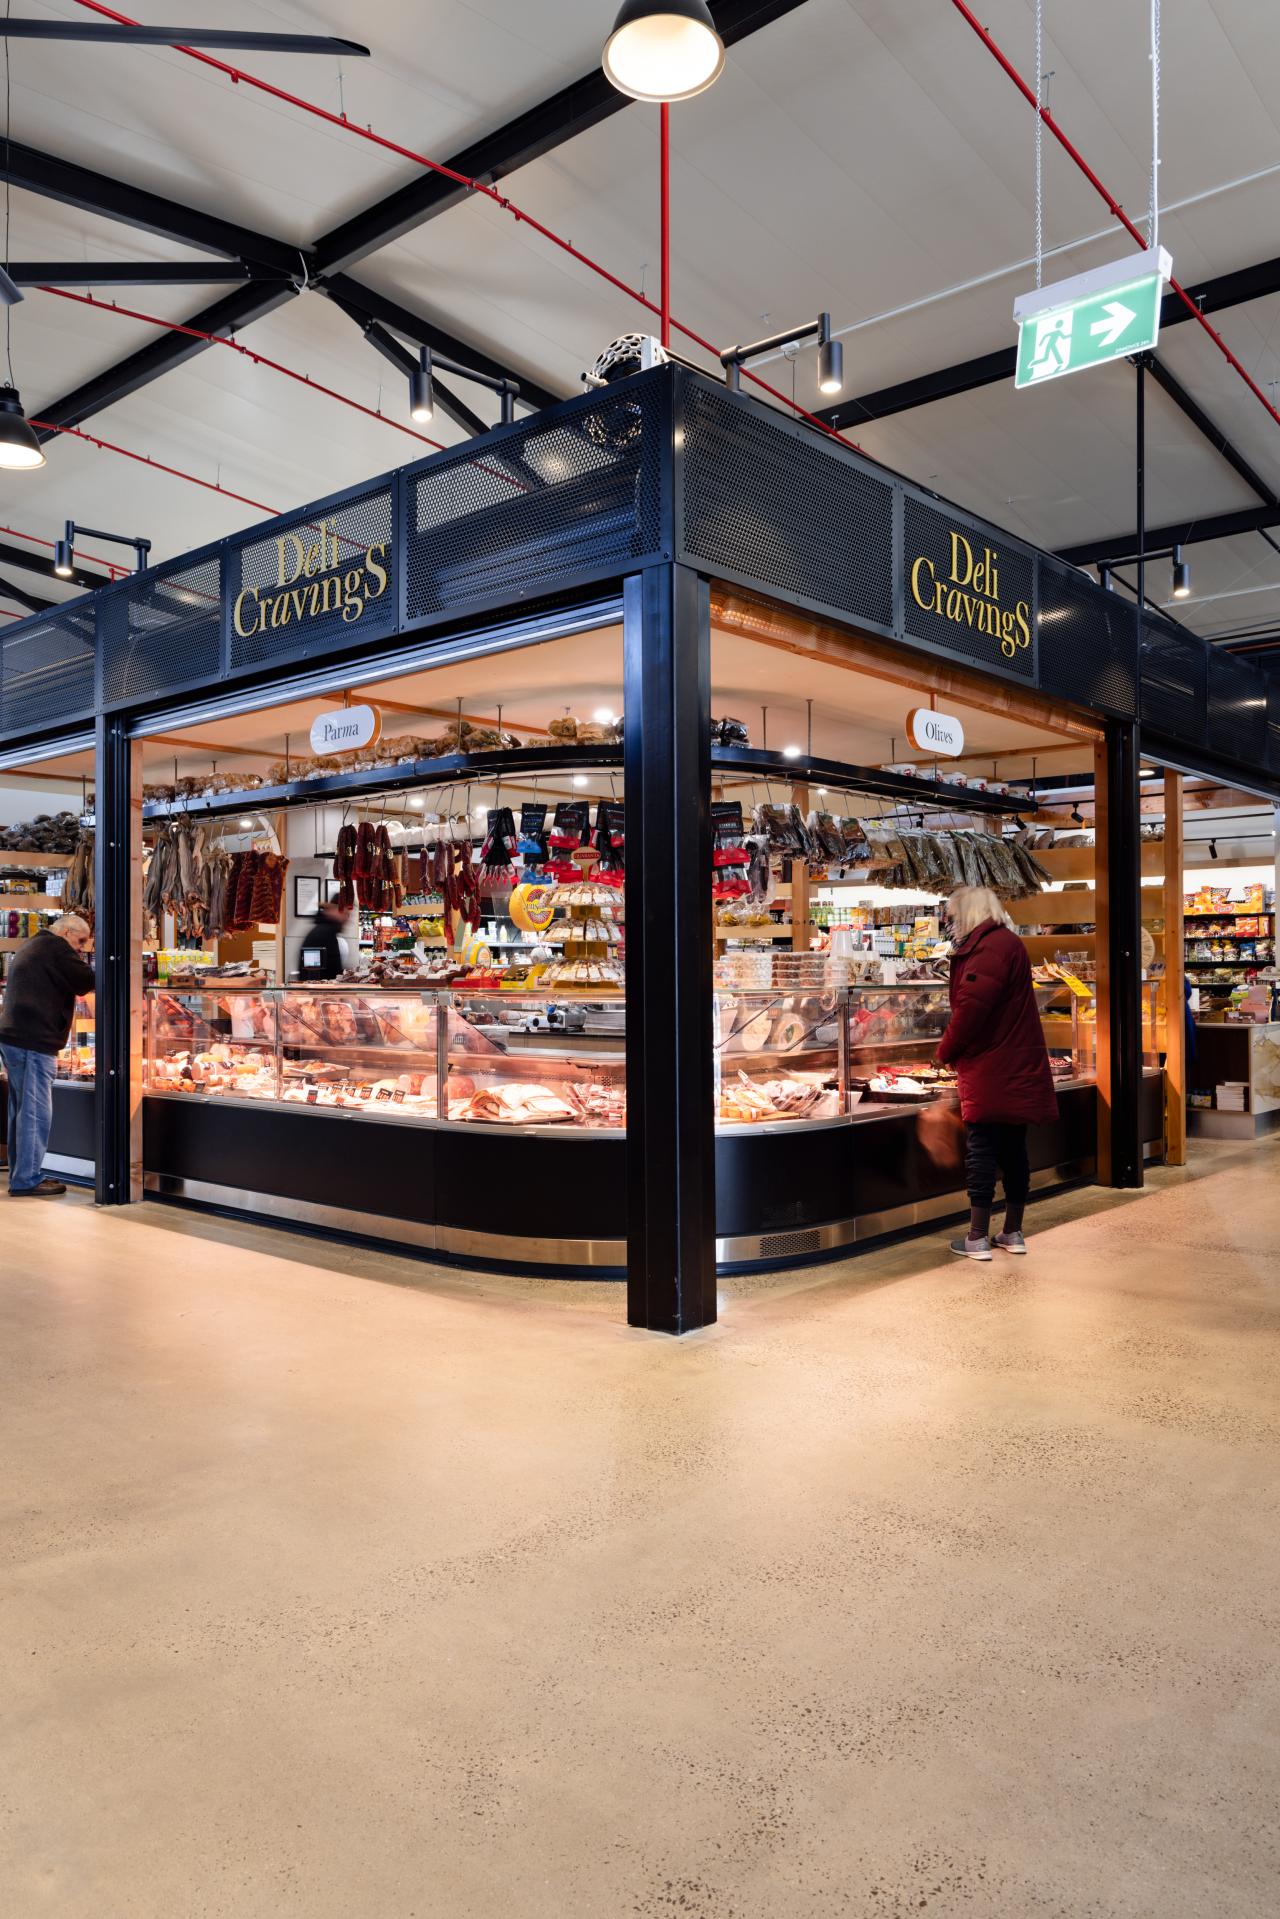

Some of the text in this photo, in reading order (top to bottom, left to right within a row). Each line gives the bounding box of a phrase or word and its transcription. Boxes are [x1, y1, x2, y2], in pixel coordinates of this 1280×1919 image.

[275, 517, 341, 588] Deli
[949, 531, 999, 600] Deli
[324, 722, 359, 742] Parma
[925, 721, 953, 744] Olives
